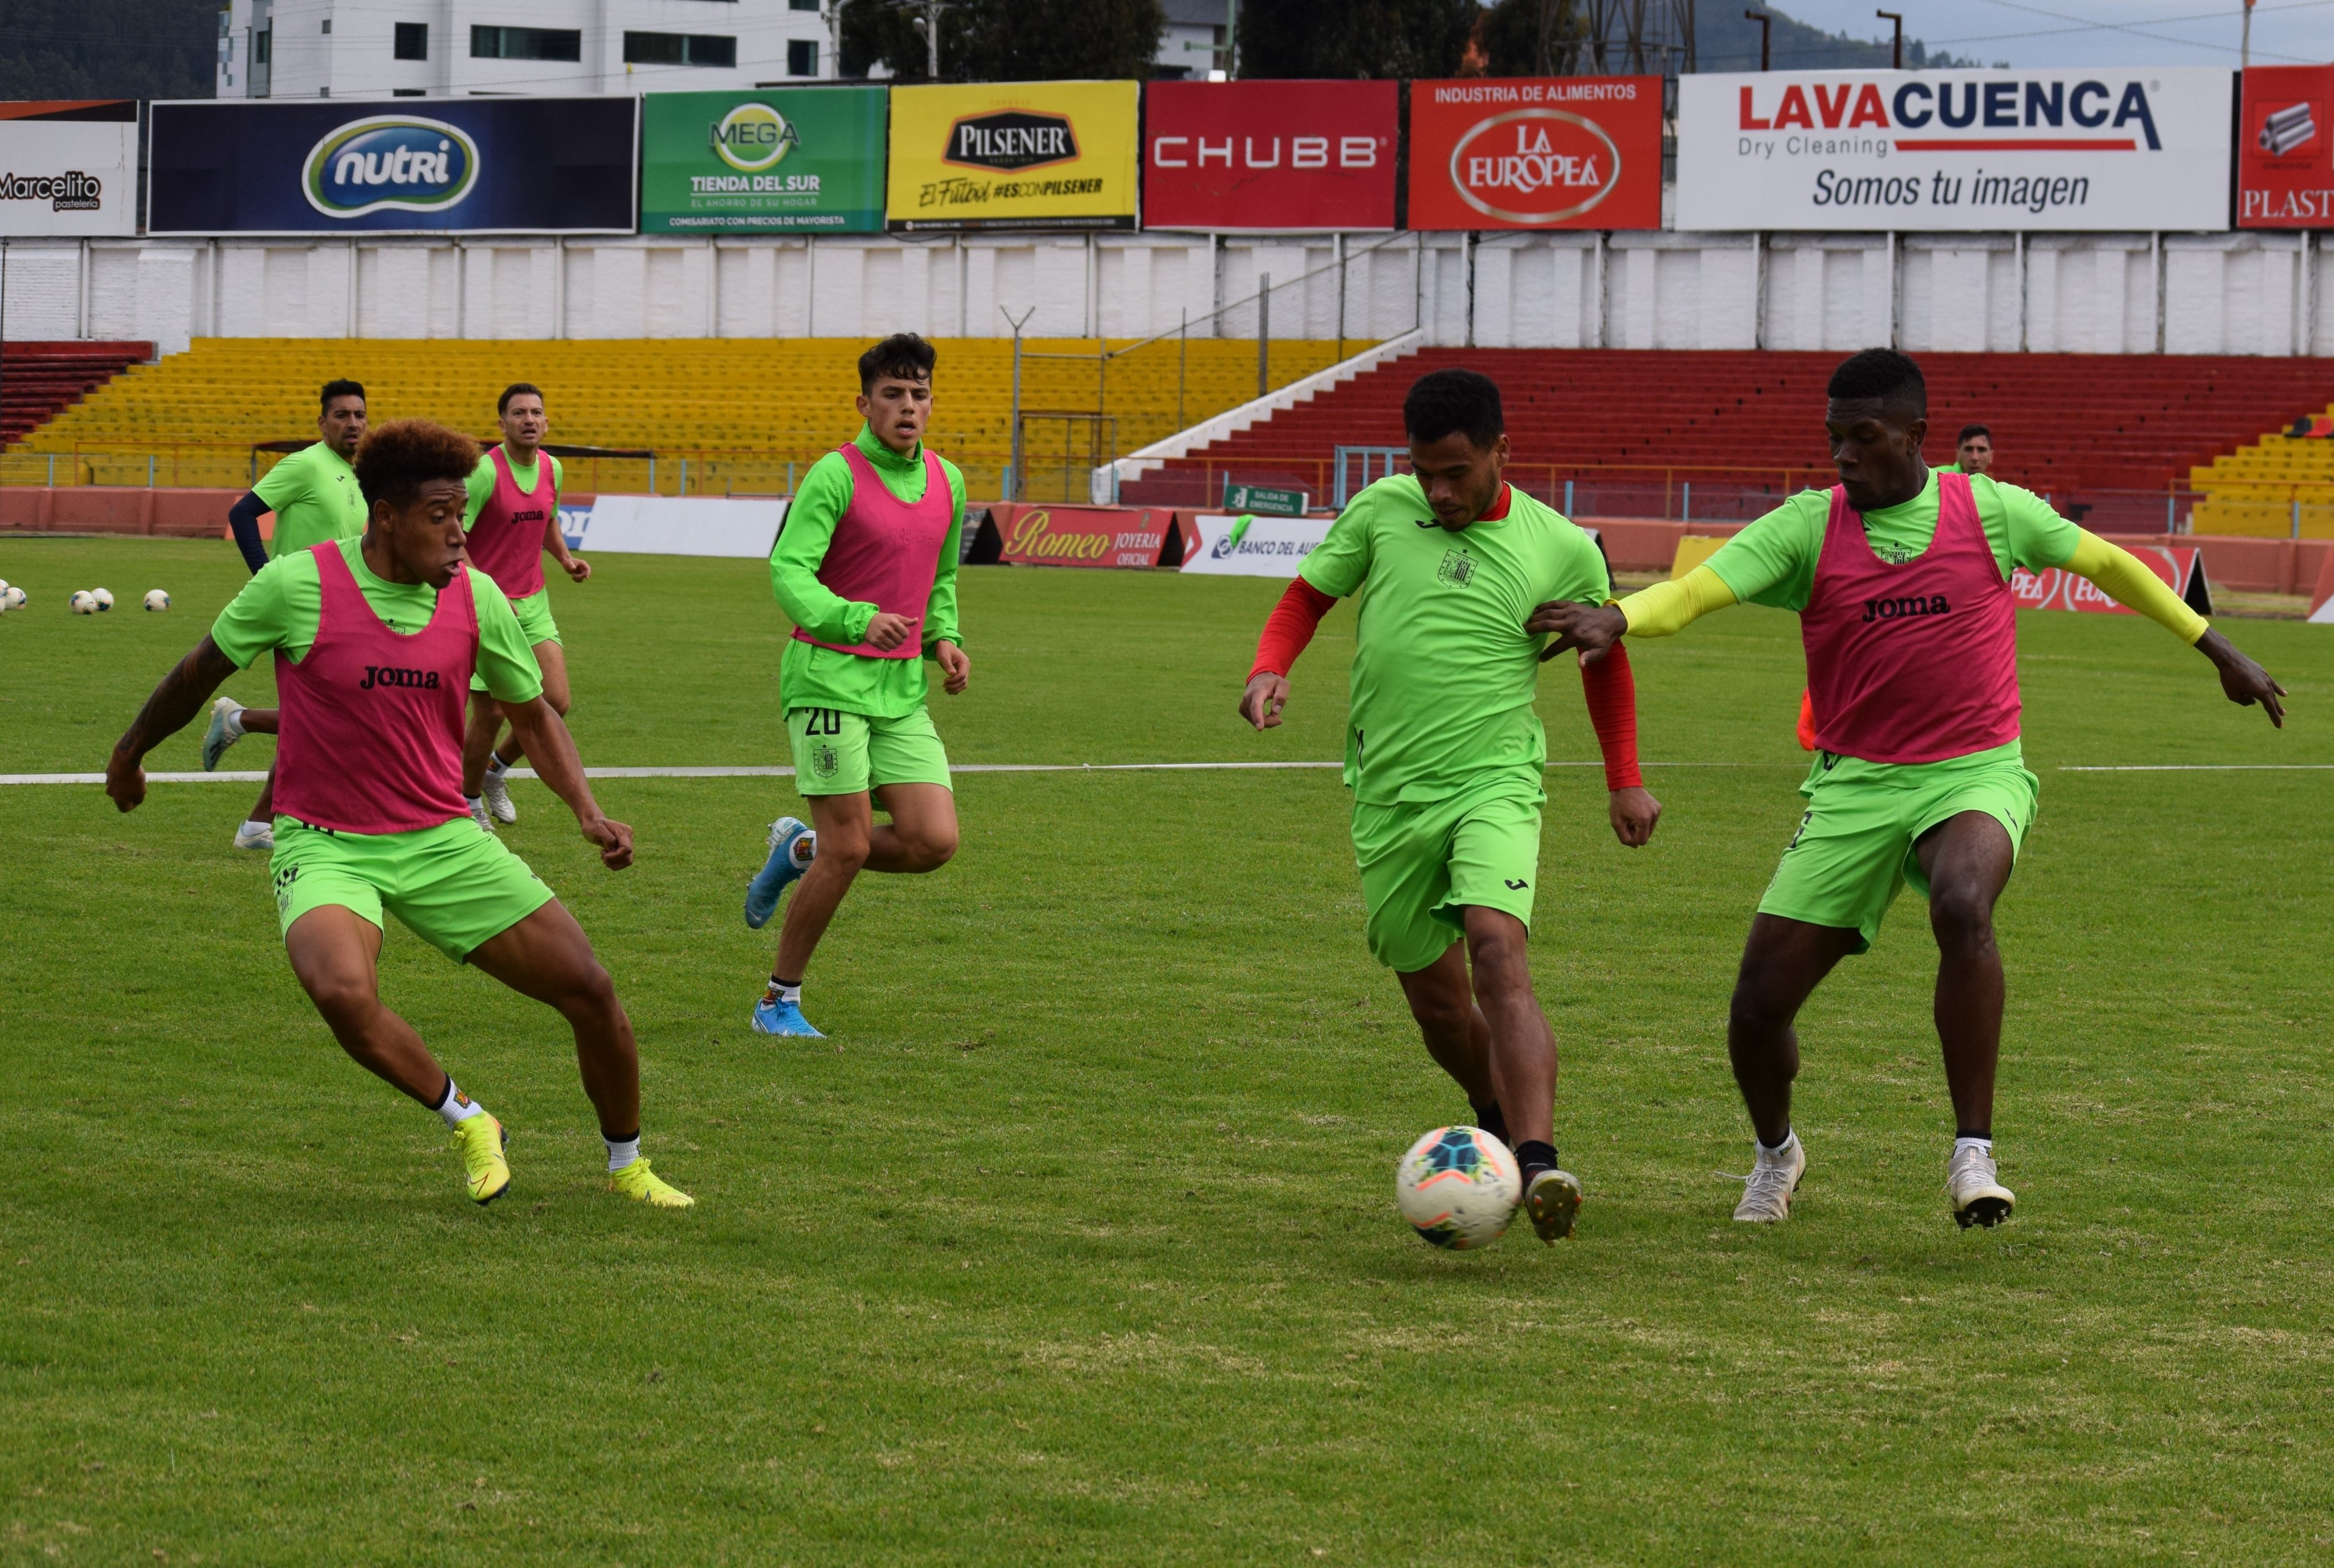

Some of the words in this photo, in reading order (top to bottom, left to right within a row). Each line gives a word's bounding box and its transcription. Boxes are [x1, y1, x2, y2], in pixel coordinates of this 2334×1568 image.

[1435, 87, 1519, 103] INDUSTRIA
[1523, 86, 1543, 101] DE
[1547, 84, 1636, 101] ALIMENTOS
[1740, 80, 2162, 150] LAVACUENCA
[709, 121, 800, 146] MEGA
[960, 125, 1066, 157] PILSENER
[1517, 125, 1552, 154] LA
[1154, 136, 1377, 168] CHUBB
[1739, 137, 1774, 160] Dry
[1786, 136, 1887, 158] Cleaning
[0, 174, 99, 197] Marcelito
[690, 176, 750, 191] TIENDA
[753, 175, 784, 191] DEL
[786, 175, 820, 190] SUR
[1469, 154, 1599, 193] EUROPEA
[1813, 169, 1921, 205] Somos
[1931, 170, 1961, 205] tu
[1971, 169, 2090, 213] imagen
[2243, 189, 2334, 218] PLAST
[669, 217, 725, 226] COMISARIATO
[747, 217, 782, 225] PRECIOS
[796, 216, 845, 224] MAYORISTA
[1250, 500, 1293, 512] EMERGENCIA
[1255, 491, 1279, 500] SALIDA
[1005, 510, 1109, 559] Romeo
[1116, 553, 1149, 566] OFICIAL
[1238, 540, 1276, 555] BANCO
[1276, 541, 1295, 555] DEL
[805, 707, 840, 736] 20
